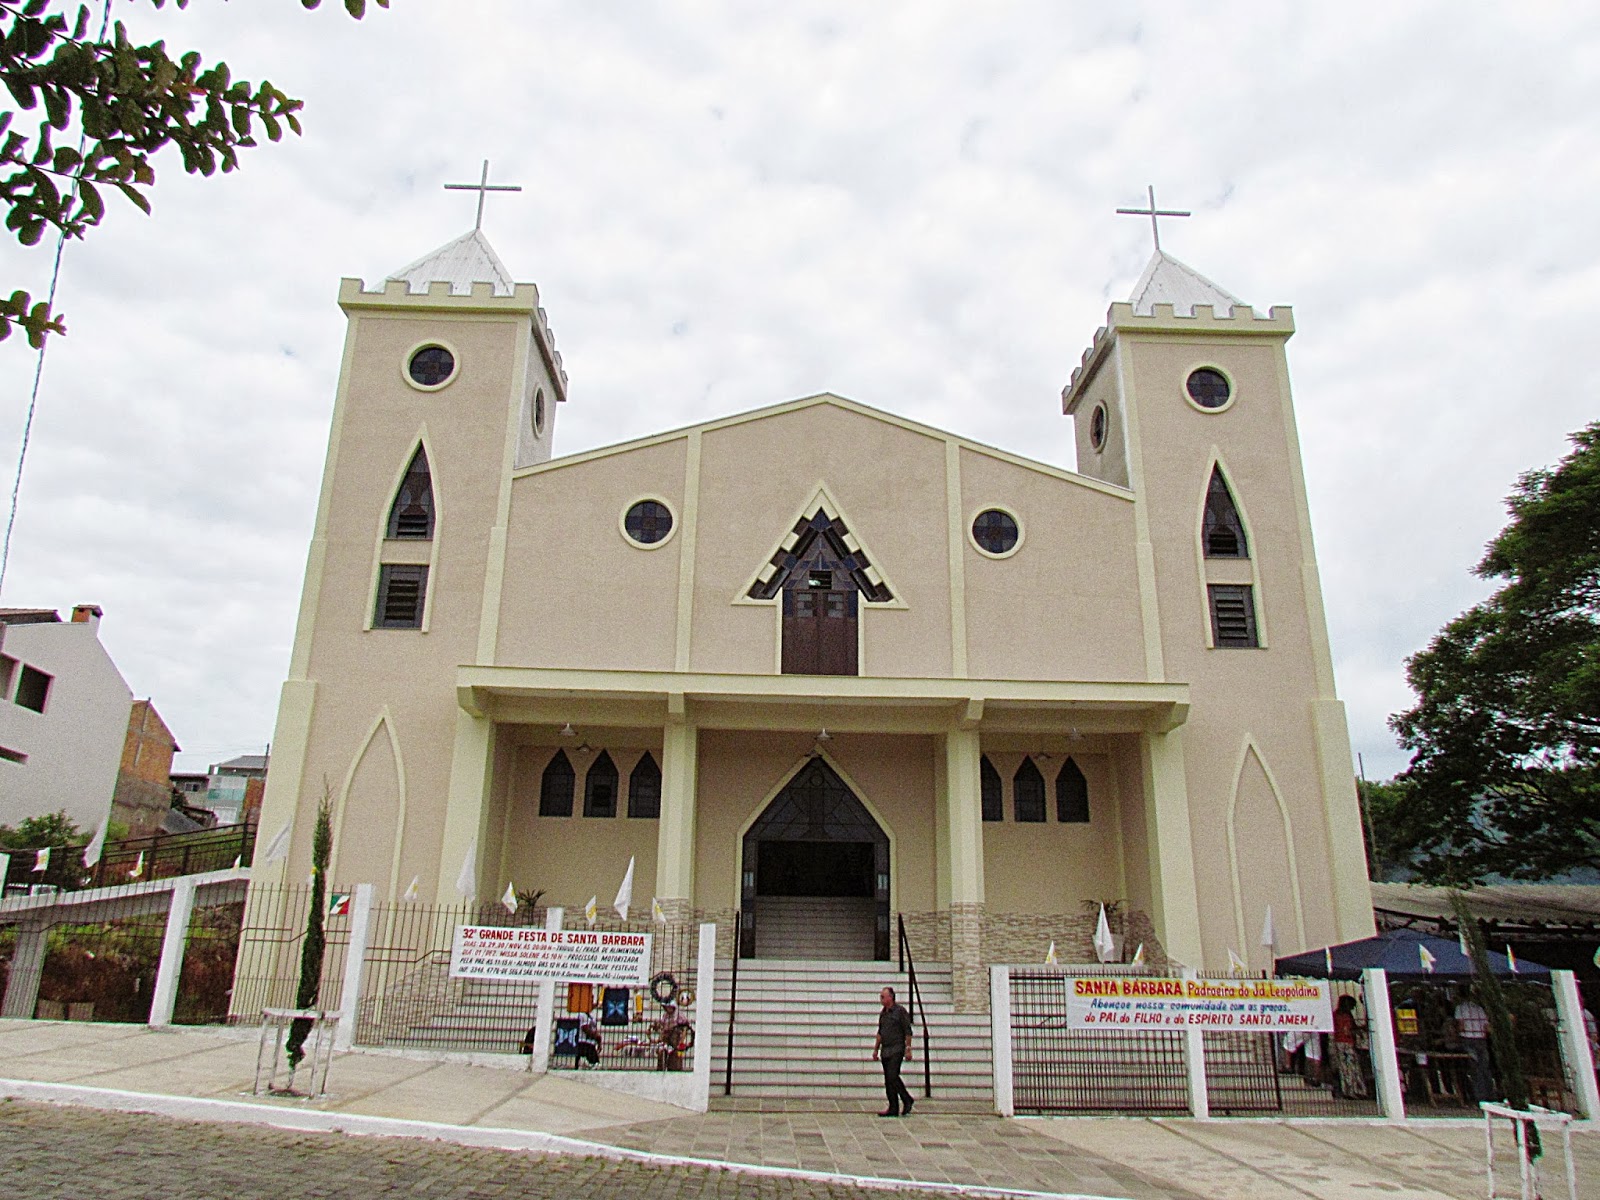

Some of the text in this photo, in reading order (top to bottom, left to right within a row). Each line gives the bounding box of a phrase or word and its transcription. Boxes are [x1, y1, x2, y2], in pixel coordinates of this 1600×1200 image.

[479, 929, 514, 941] GRANDE
[518, 931, 547, 942] FESTA
[551, 932, 563, 943] DE
[567, 933, 598, 944] SANTA
[1075, 980, 1118, 995] SANTA
[1187, 982, 1235, 997] Padroeira
[1239, 984, 1249, 997] do
[1270, 983, 1318, 1000] Leopoldina
[1091, 998, 1131, 1009] Abençoe
[1136, 1002, 1164, 1010] nossa
[1170, 1000, 1227, 1011] comunidade
[1084, 1012, 1096, 1022] do
[1120, 1013, 1130, 1023] do
[1134, 1012, 1162, 1024] FILHO
[1174, 1014, 1184, 1024] do
[1188, 1012, 1234, 1025] ESPÍRITO
